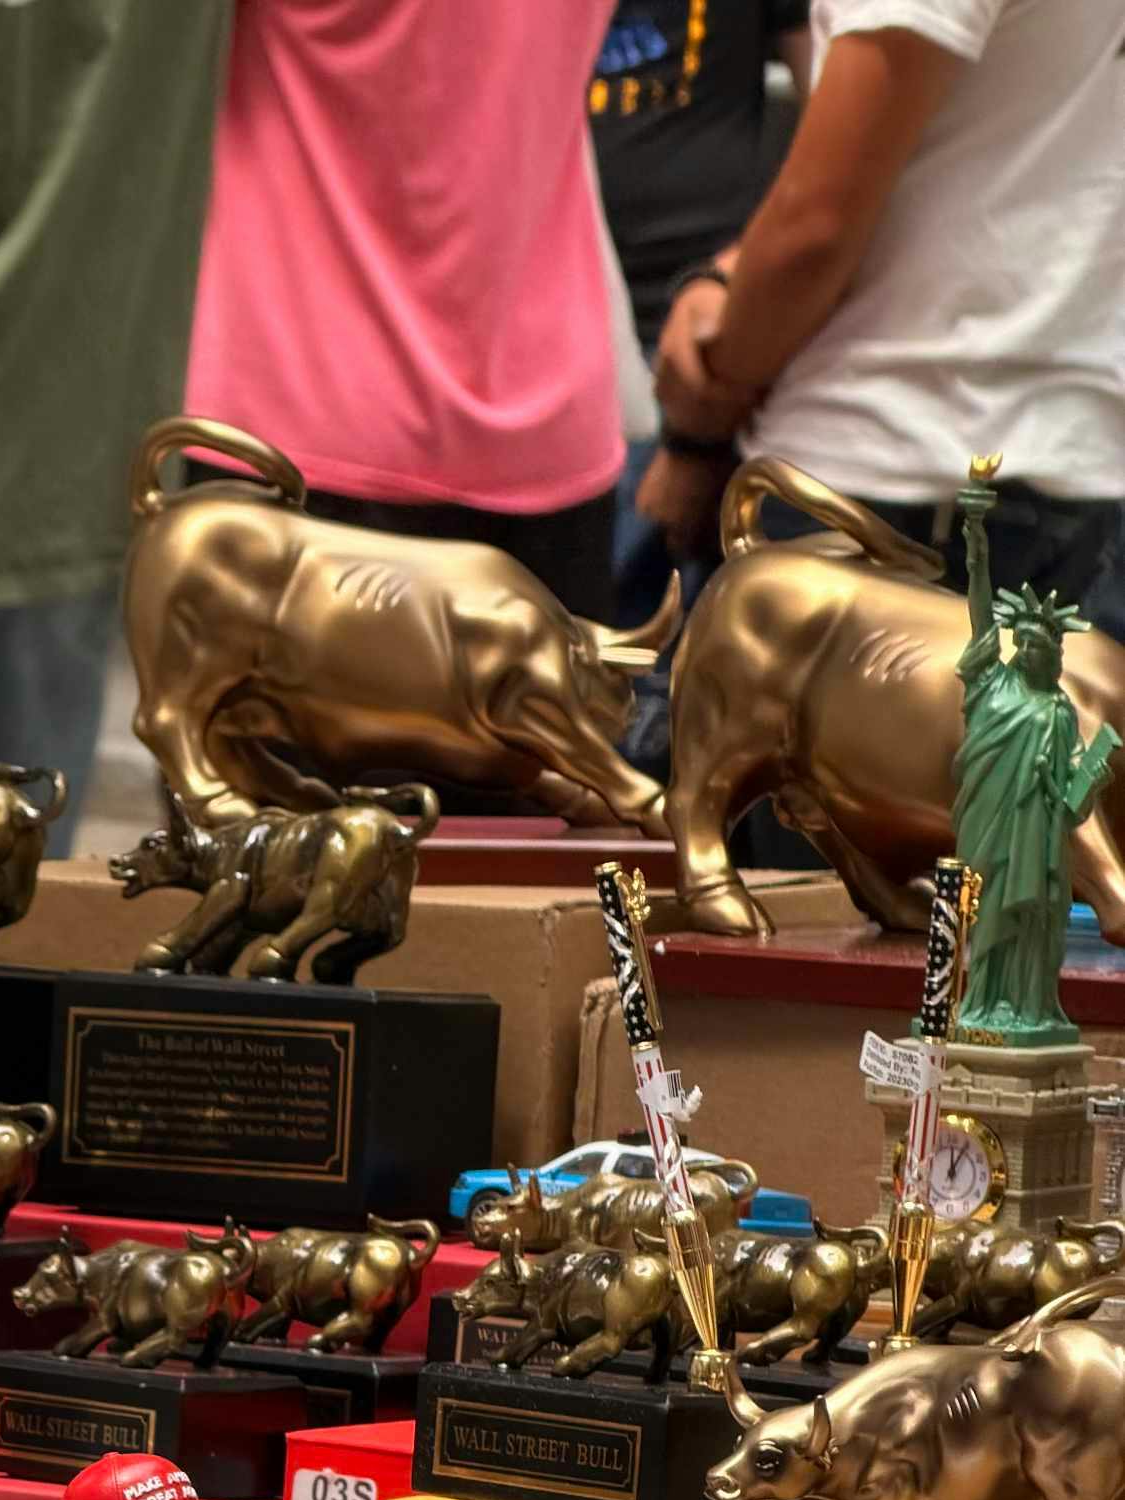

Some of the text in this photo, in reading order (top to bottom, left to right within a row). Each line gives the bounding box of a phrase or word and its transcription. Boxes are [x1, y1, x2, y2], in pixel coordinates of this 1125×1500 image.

[4, 1409, 140, 1449] WALL STREET BULL
[453, 1425, 624, 1472] WALL STREET BULL
